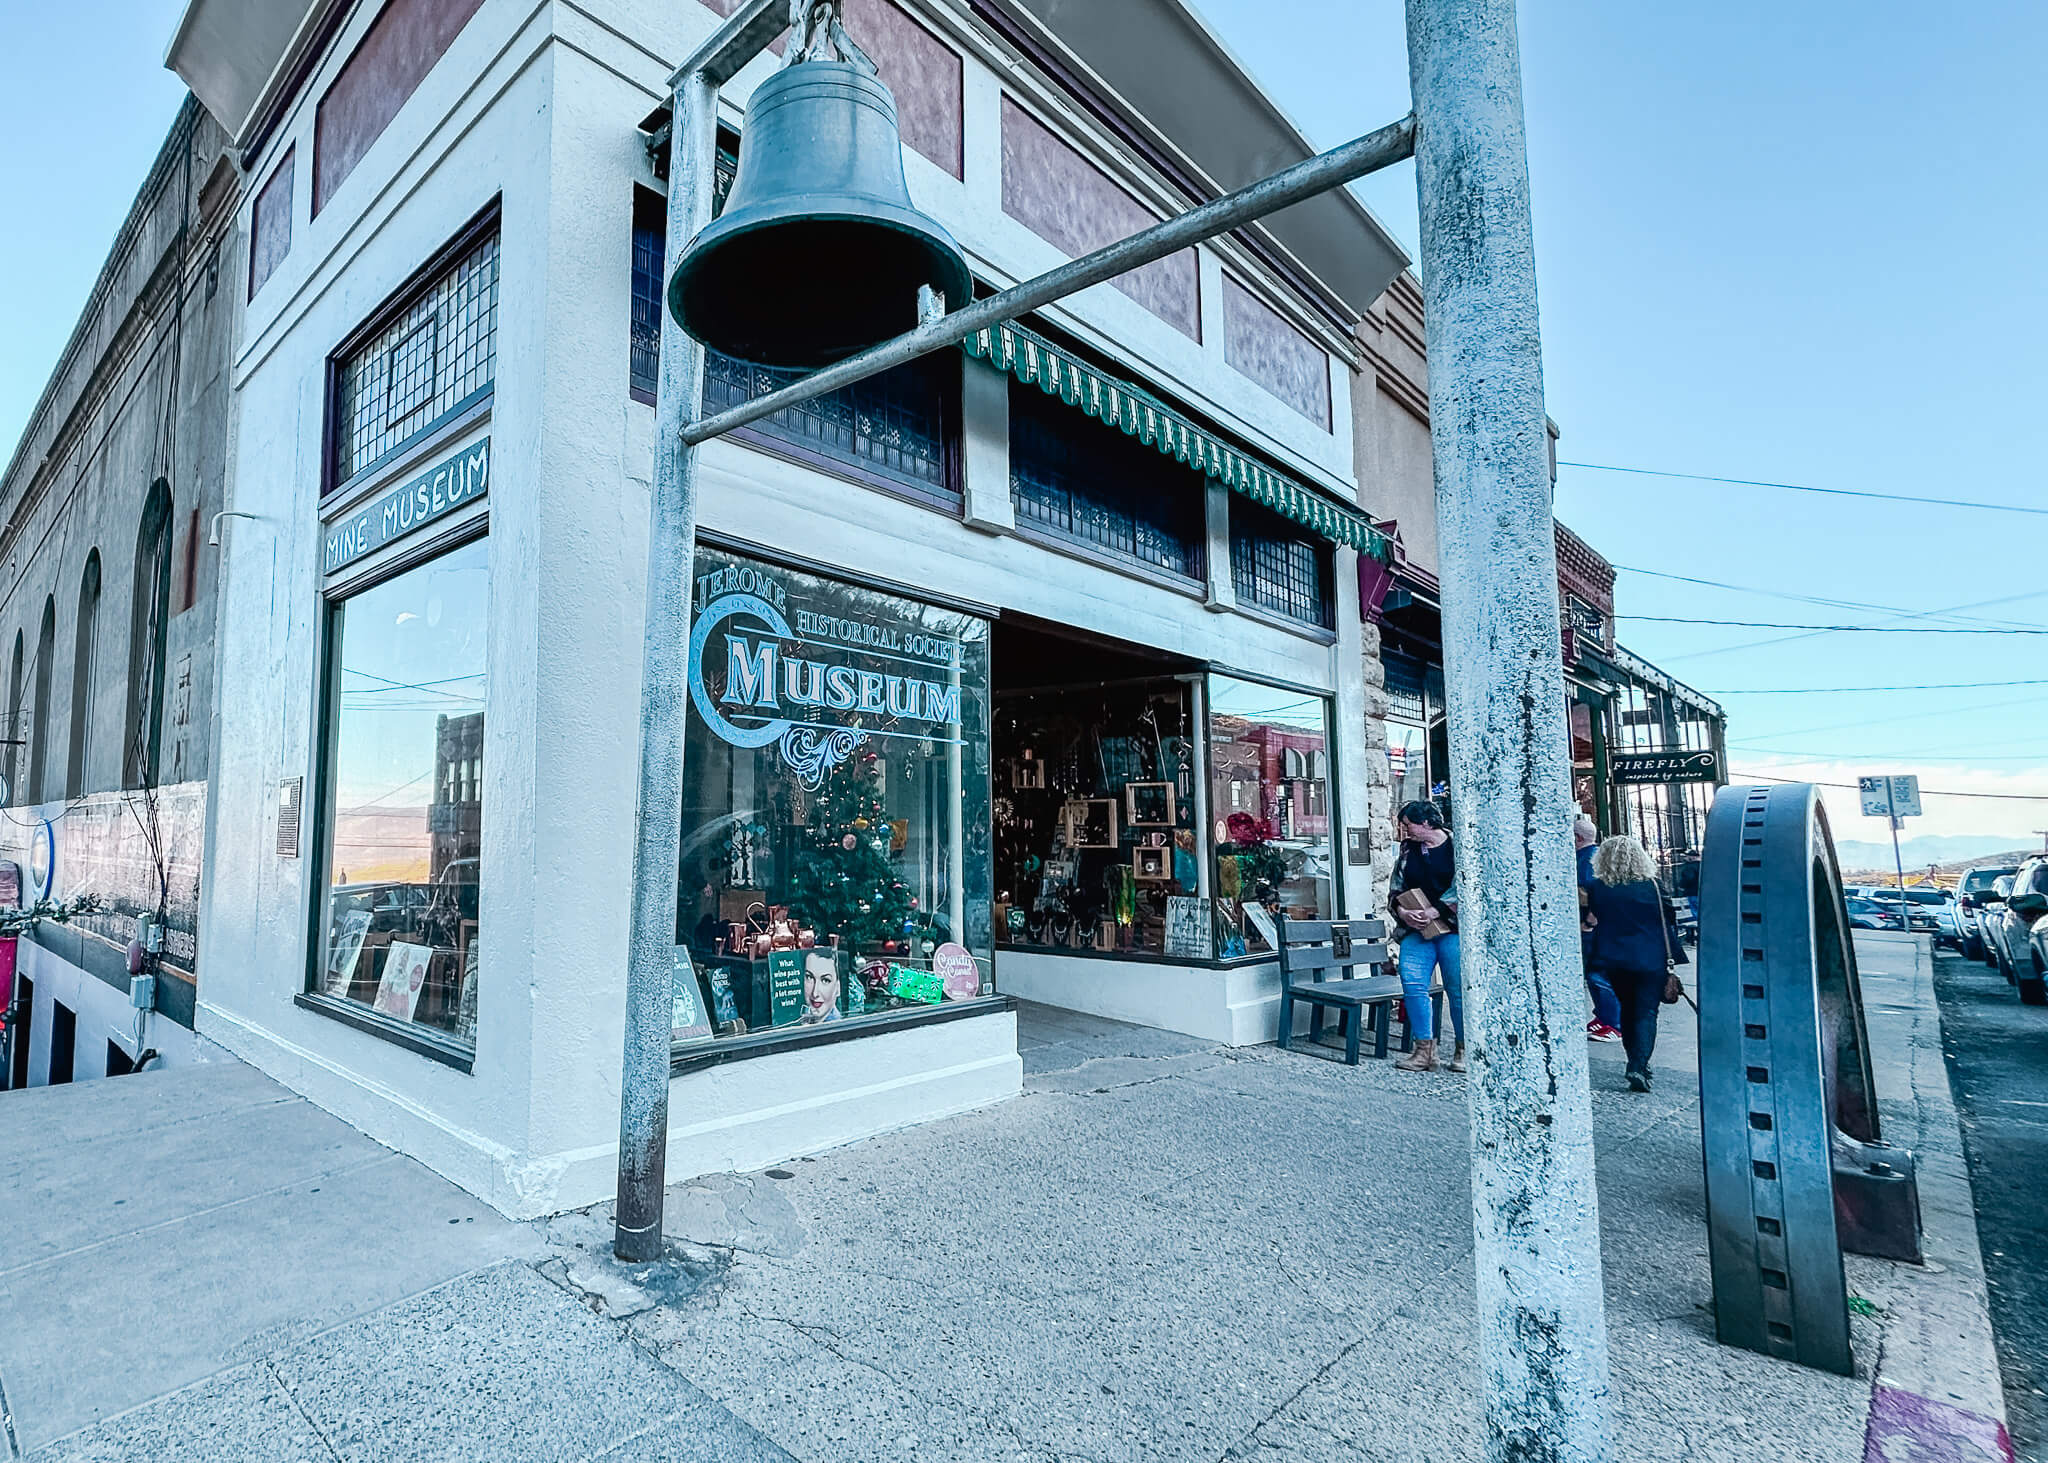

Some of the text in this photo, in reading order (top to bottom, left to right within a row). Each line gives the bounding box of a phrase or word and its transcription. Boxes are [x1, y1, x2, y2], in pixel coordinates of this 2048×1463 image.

[326, 446, 489, 569] MINE MUSEUM
[693, 567, 787, 615] JEROME
[796, 609, 967, 663] HISTORICAL SOCIETY
[720, 633, 963, 726] MUSEUM
[1613, 757, 1690, 771] FIREFLY
[779, 959, 794, 967] What
[774, 969, 801, 978] wine pairs
[775, 978, 800, 988] best with
[781, 998, 797, 1007] wine?
